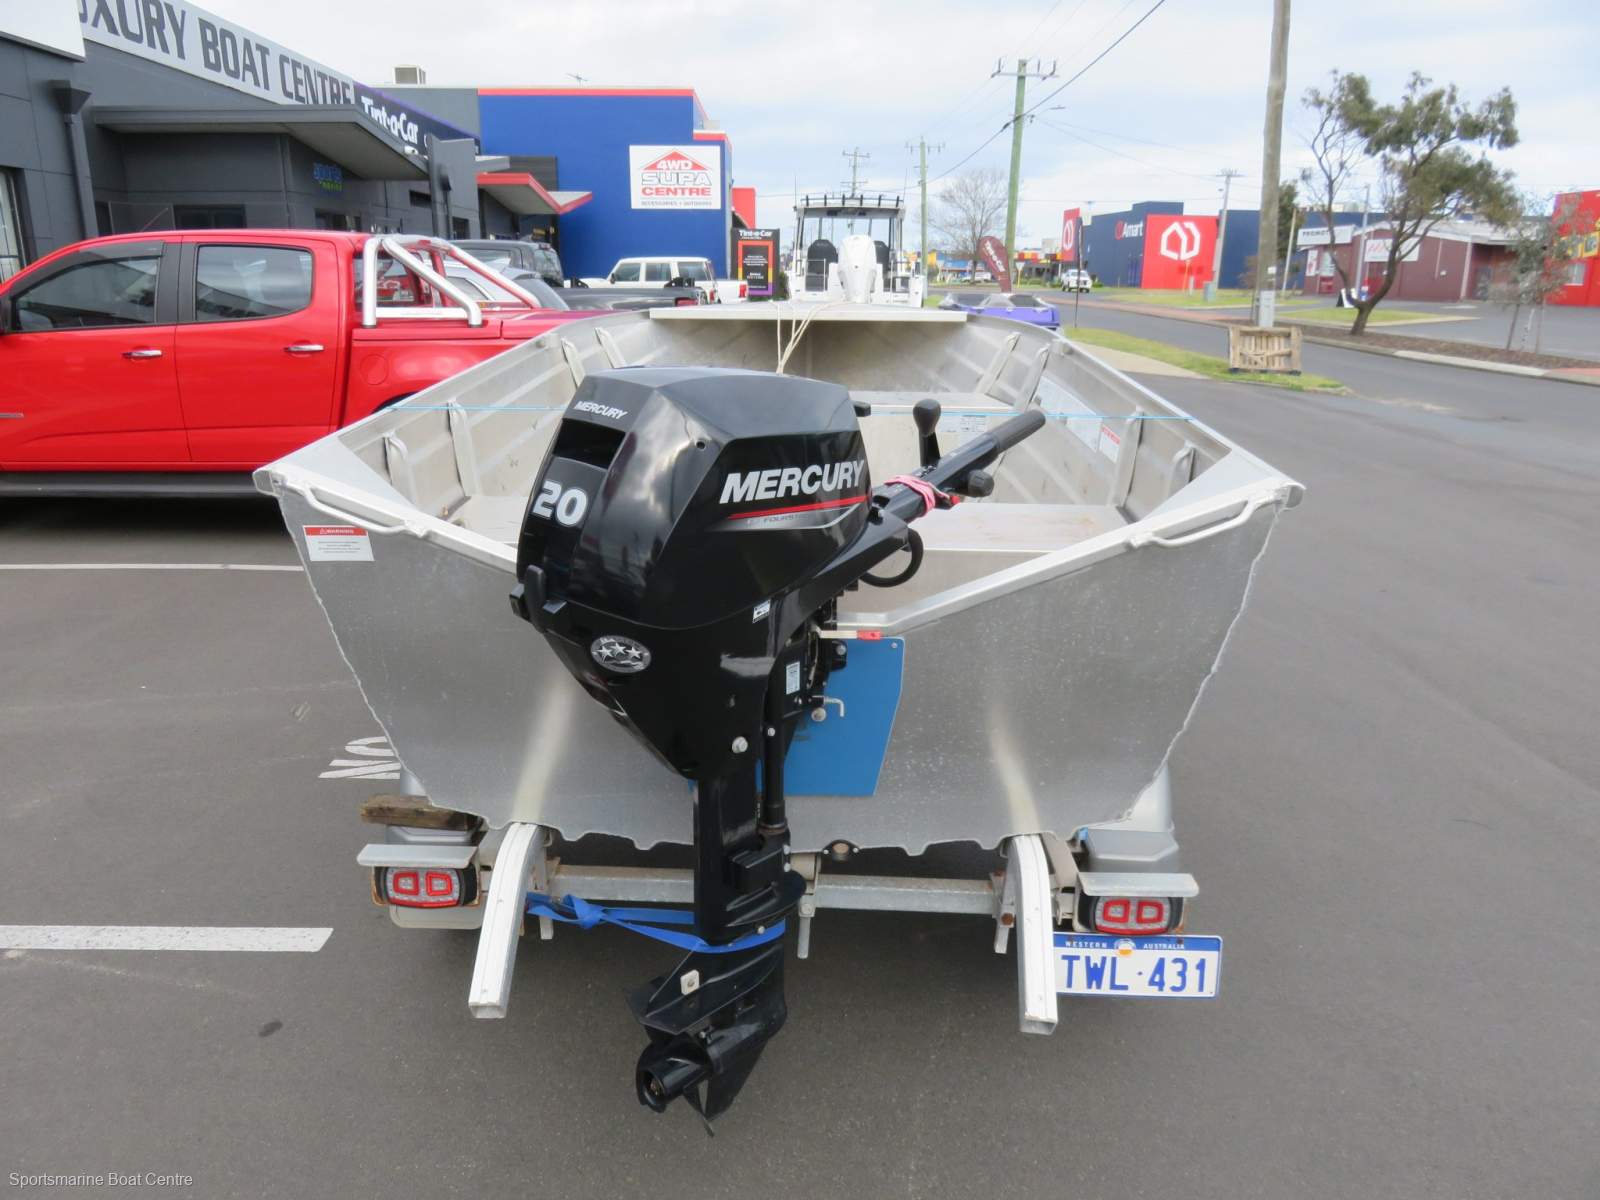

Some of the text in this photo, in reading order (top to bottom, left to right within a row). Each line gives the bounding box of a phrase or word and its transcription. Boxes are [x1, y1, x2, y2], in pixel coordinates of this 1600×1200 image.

[198, 17, 270, 91] BOAT
[279, 54, 351, 104] CENTRE
[656, 160, 692, 170] 4WD
[641, 172, 712, 186] SUPA
[641, 187, 712, 196] CENTRE
[573, 401, 628, 419] MERCURY
[719, 460, 864, 504] MERCURY
[533, 481, 587, 526] 20
[1065, 941, 1107, 949] WESTERN
